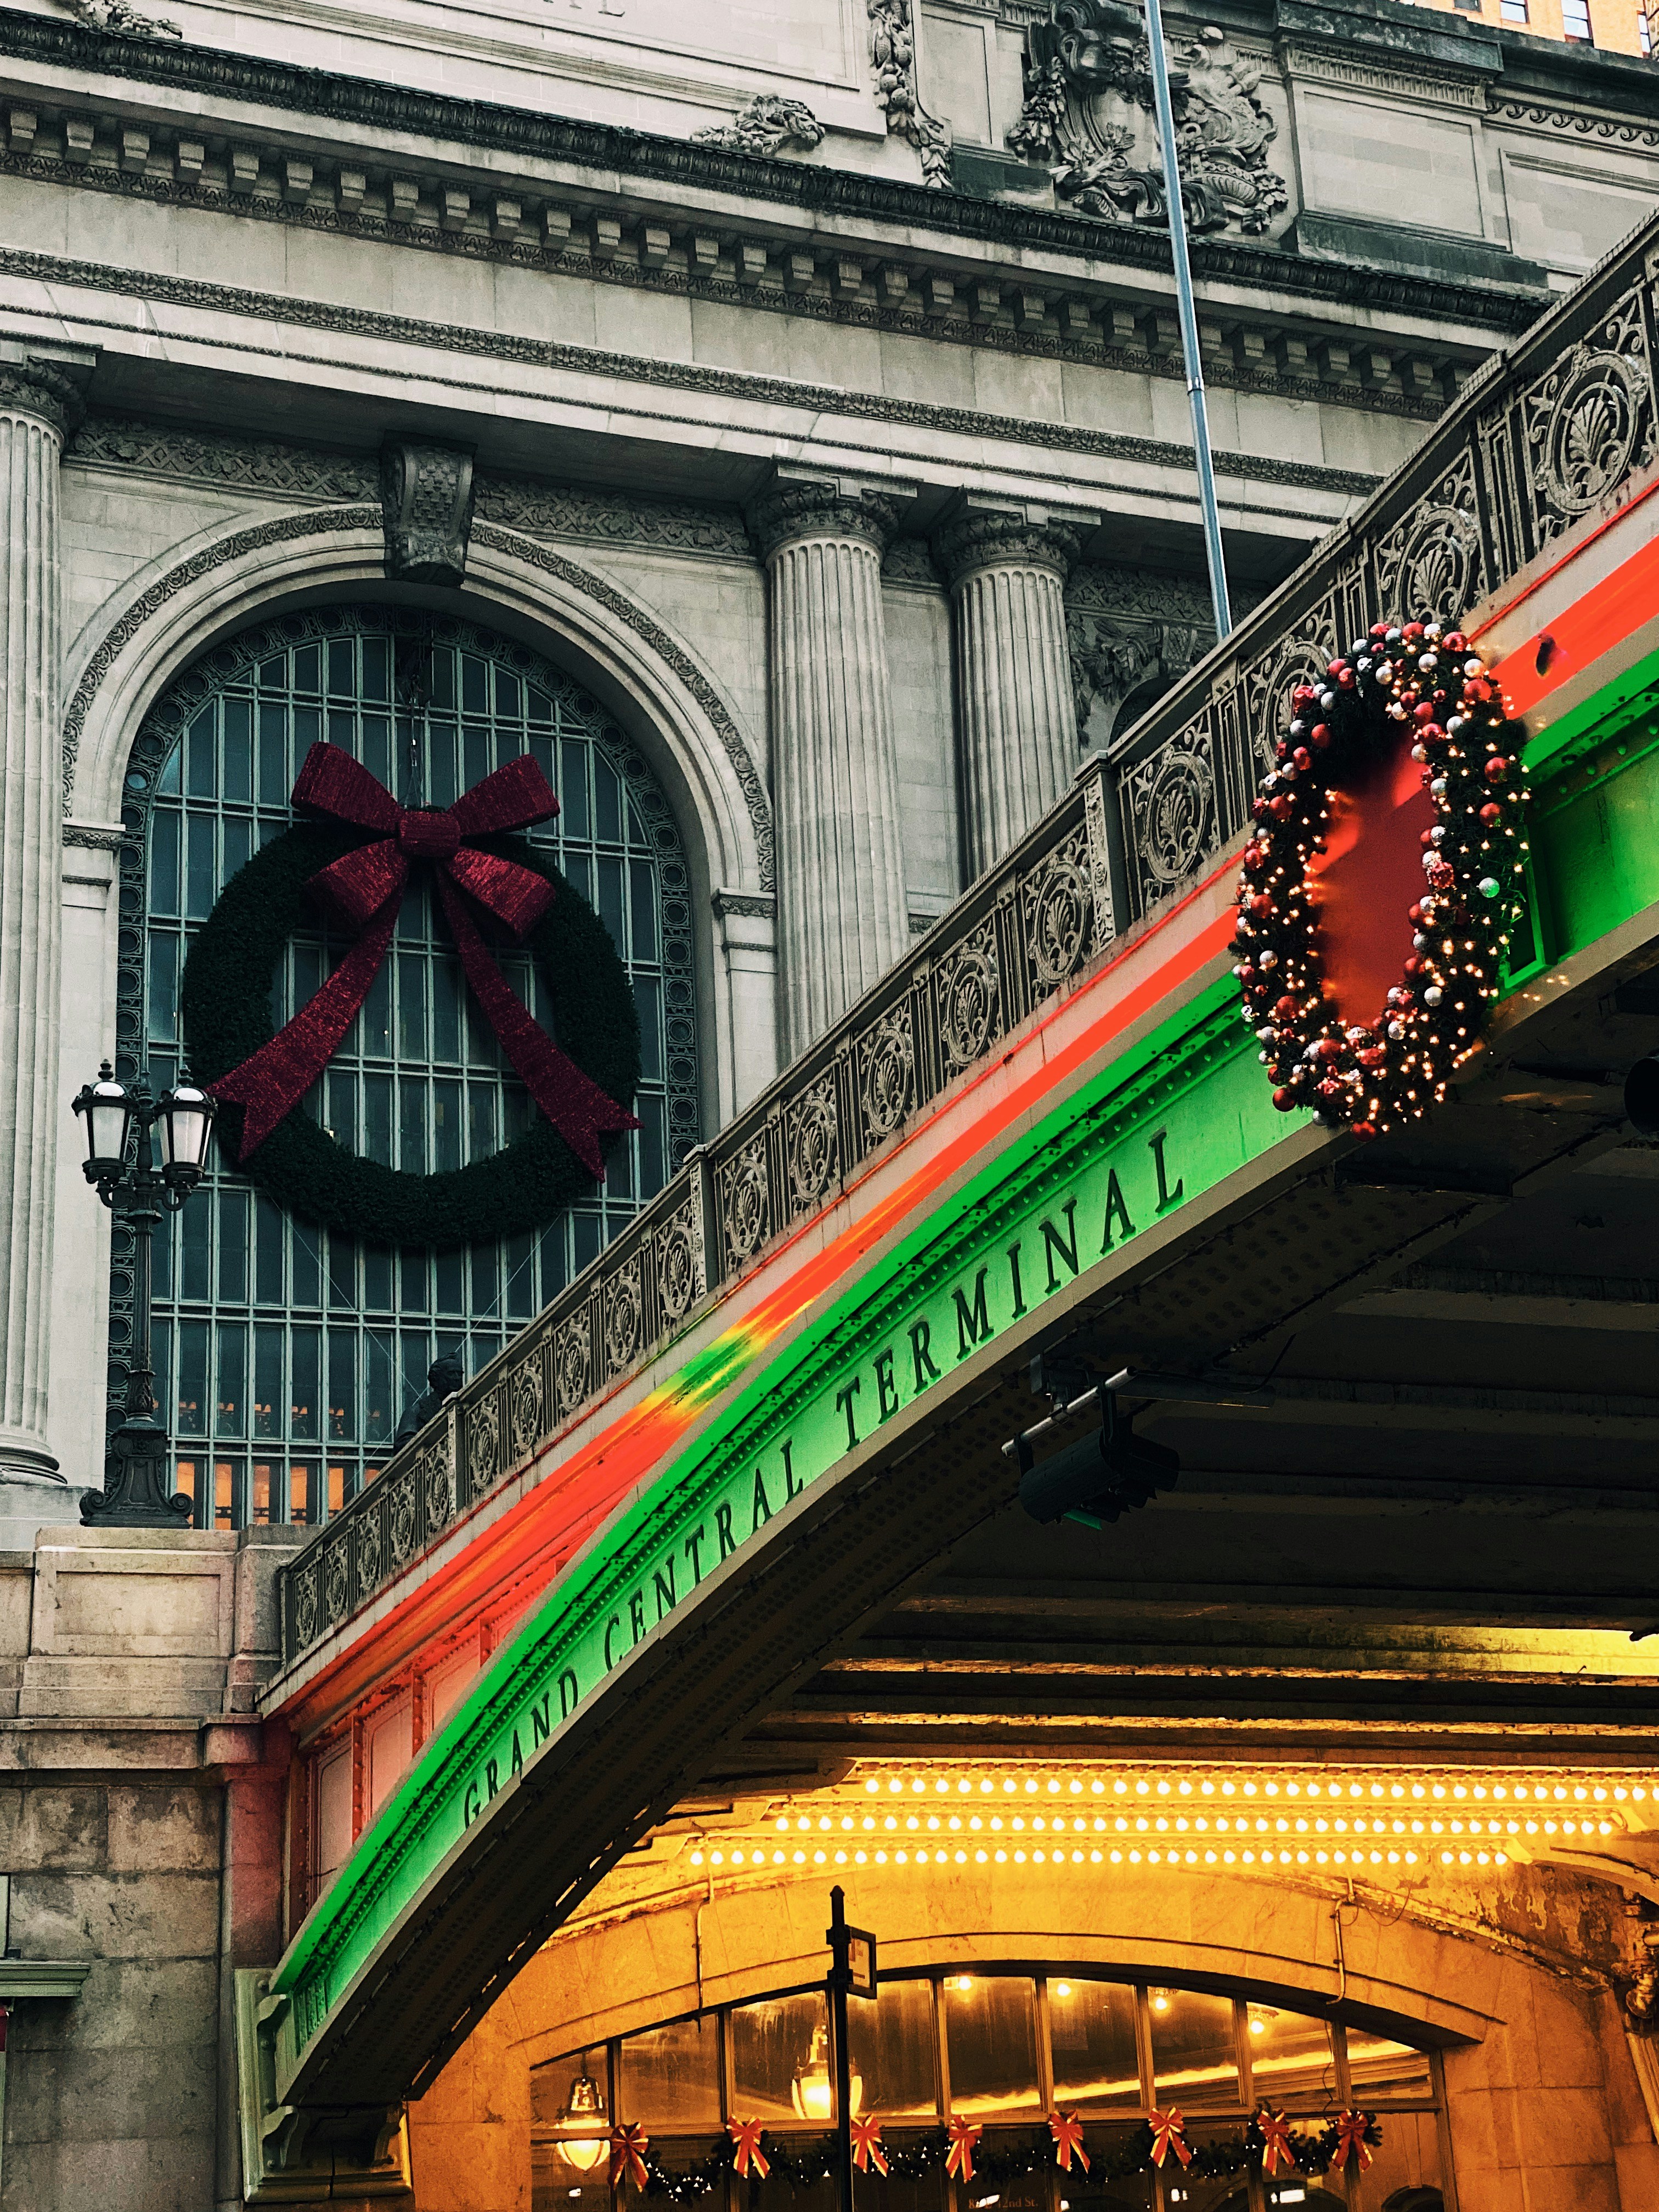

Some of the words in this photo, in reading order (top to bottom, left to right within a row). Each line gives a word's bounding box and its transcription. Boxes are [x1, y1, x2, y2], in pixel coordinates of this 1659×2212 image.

[464, 1668, 579, 1830] GRAND
[605, 1437, 803, 1672] CENTRAL
[836, 1131, 1184, 1452] TERMINAL
